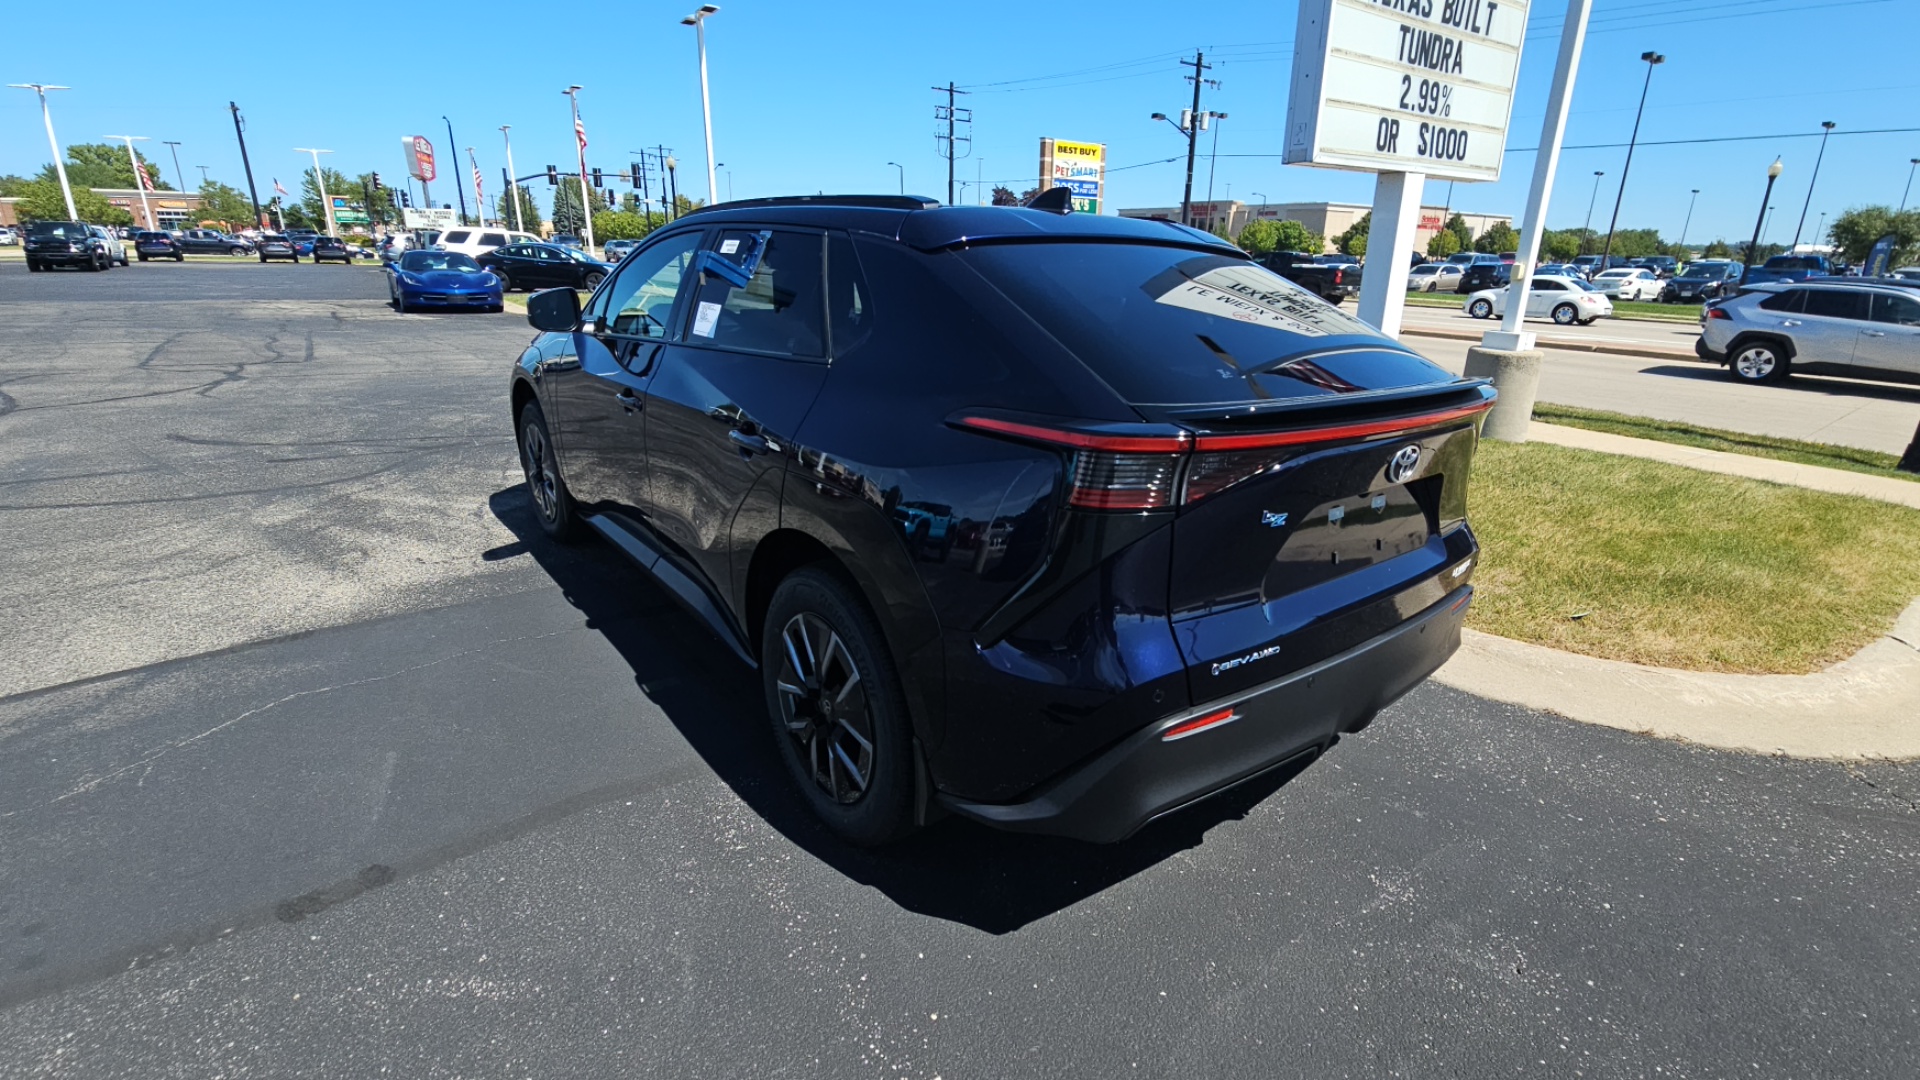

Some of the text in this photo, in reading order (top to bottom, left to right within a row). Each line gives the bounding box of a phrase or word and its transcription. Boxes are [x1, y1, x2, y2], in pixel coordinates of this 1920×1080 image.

[1441, 0, 1497, 36] BUILT
[1399, 24, 1463, 74] TUNDRA
[1399, 74, 1453, 117] 2.99%
[1058, 146, 1097, 156] BEST BUY
[1376, 117, 1399, 153] OR
